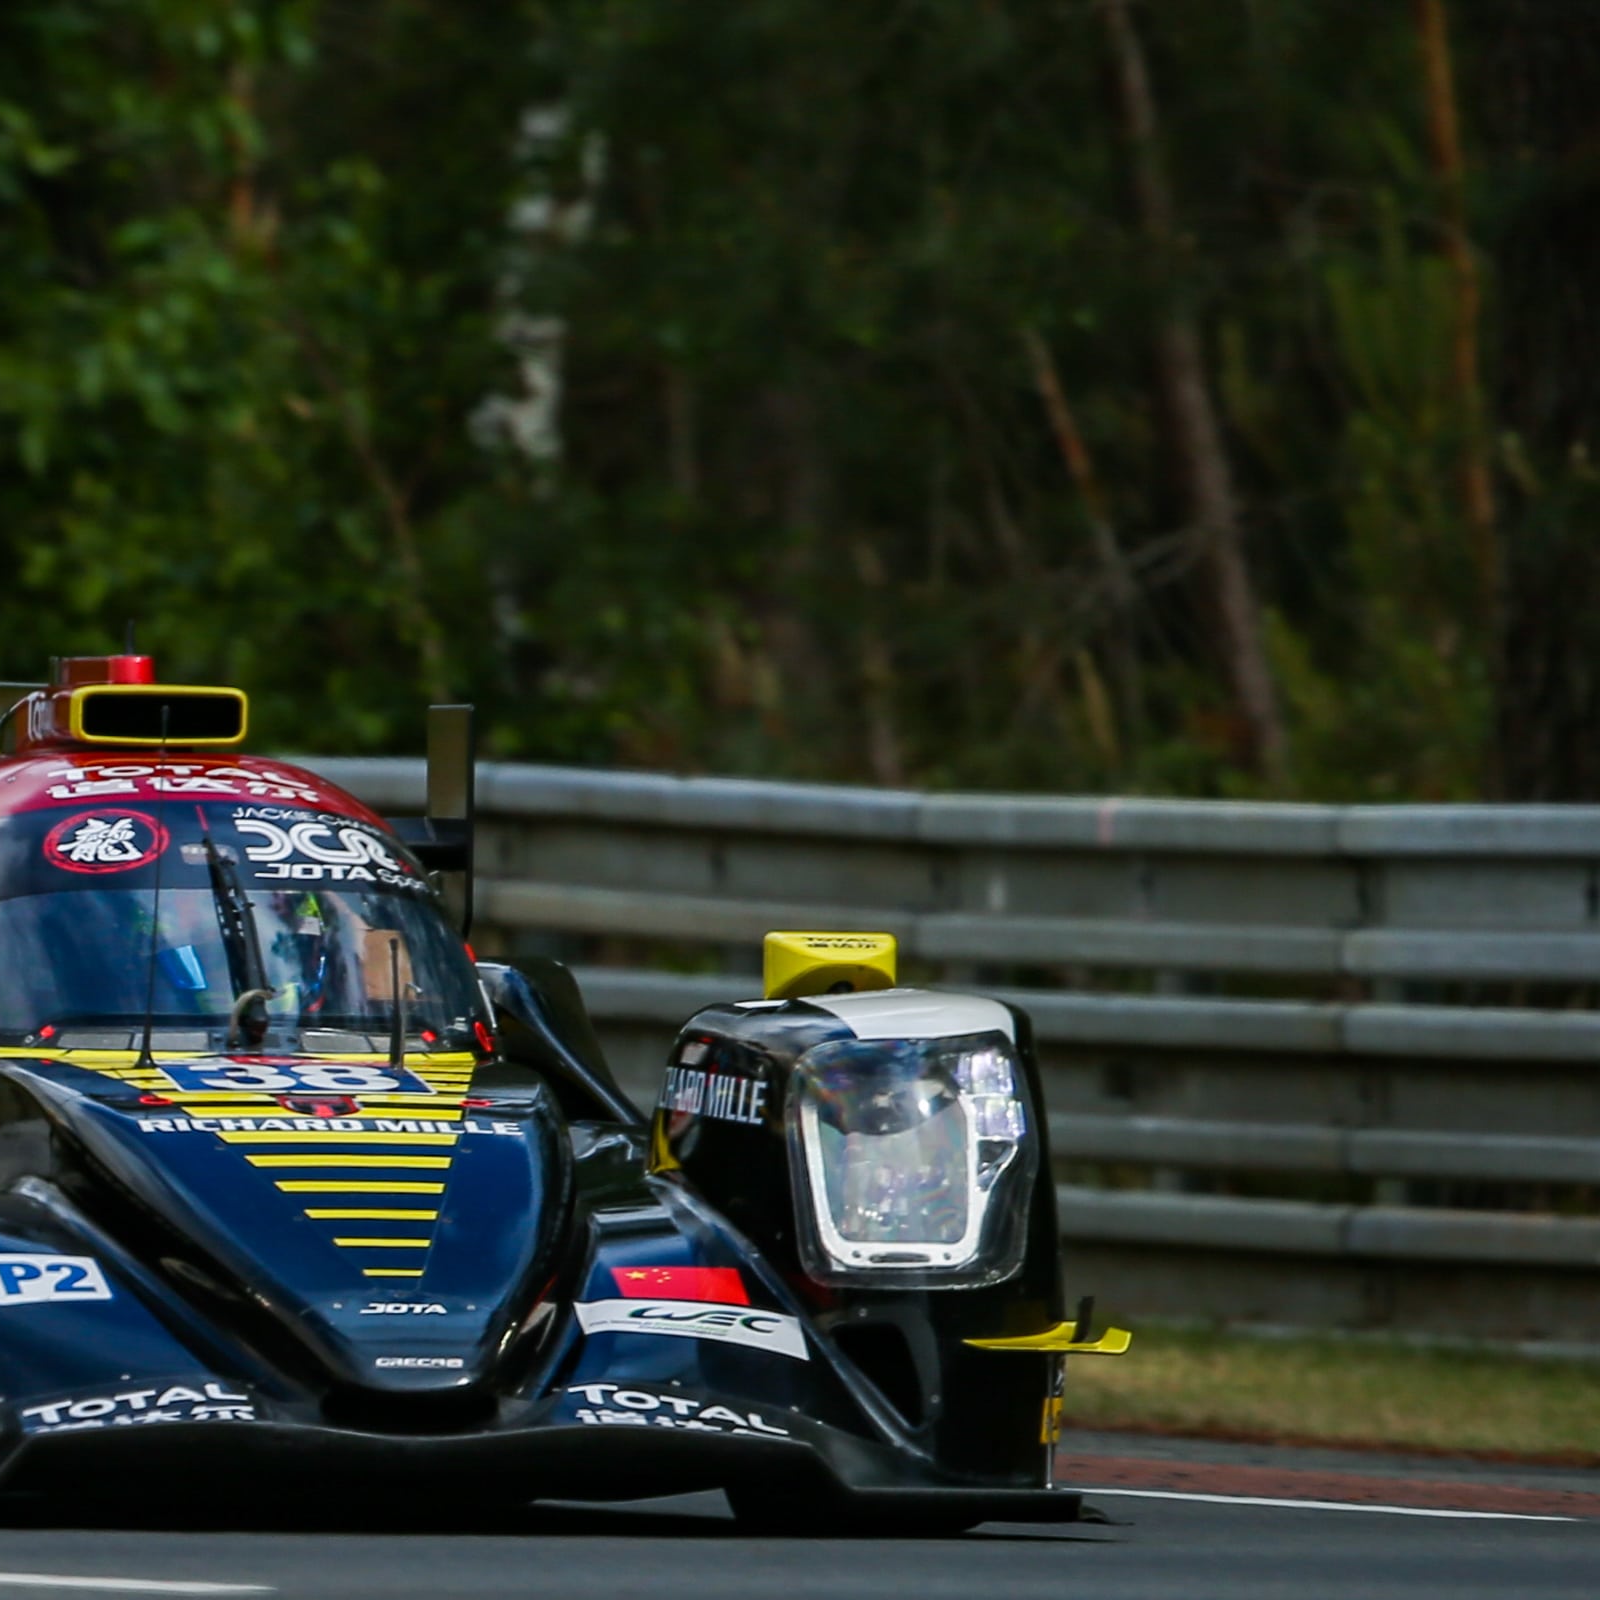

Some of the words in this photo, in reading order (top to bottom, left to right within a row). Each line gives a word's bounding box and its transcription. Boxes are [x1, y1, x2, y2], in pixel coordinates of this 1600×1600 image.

[47, 764, 310, 789] TOTAL
[253, 863, 377, 882] JOTA
[188, 1064, 401, 1090] 38
[706, 1073, 769, 1125] MILLE
[139, 1118, 366, 1133] RICHARD
[377, 1119, 524, 1137] MILLE
[360, 1302, 448, 1315] JOTA
[628, 1306, 782, 1334] WEC
[21, 1382, 248, 1425] TOTAL
[567, 1383, 790, 1436] TOTAL
